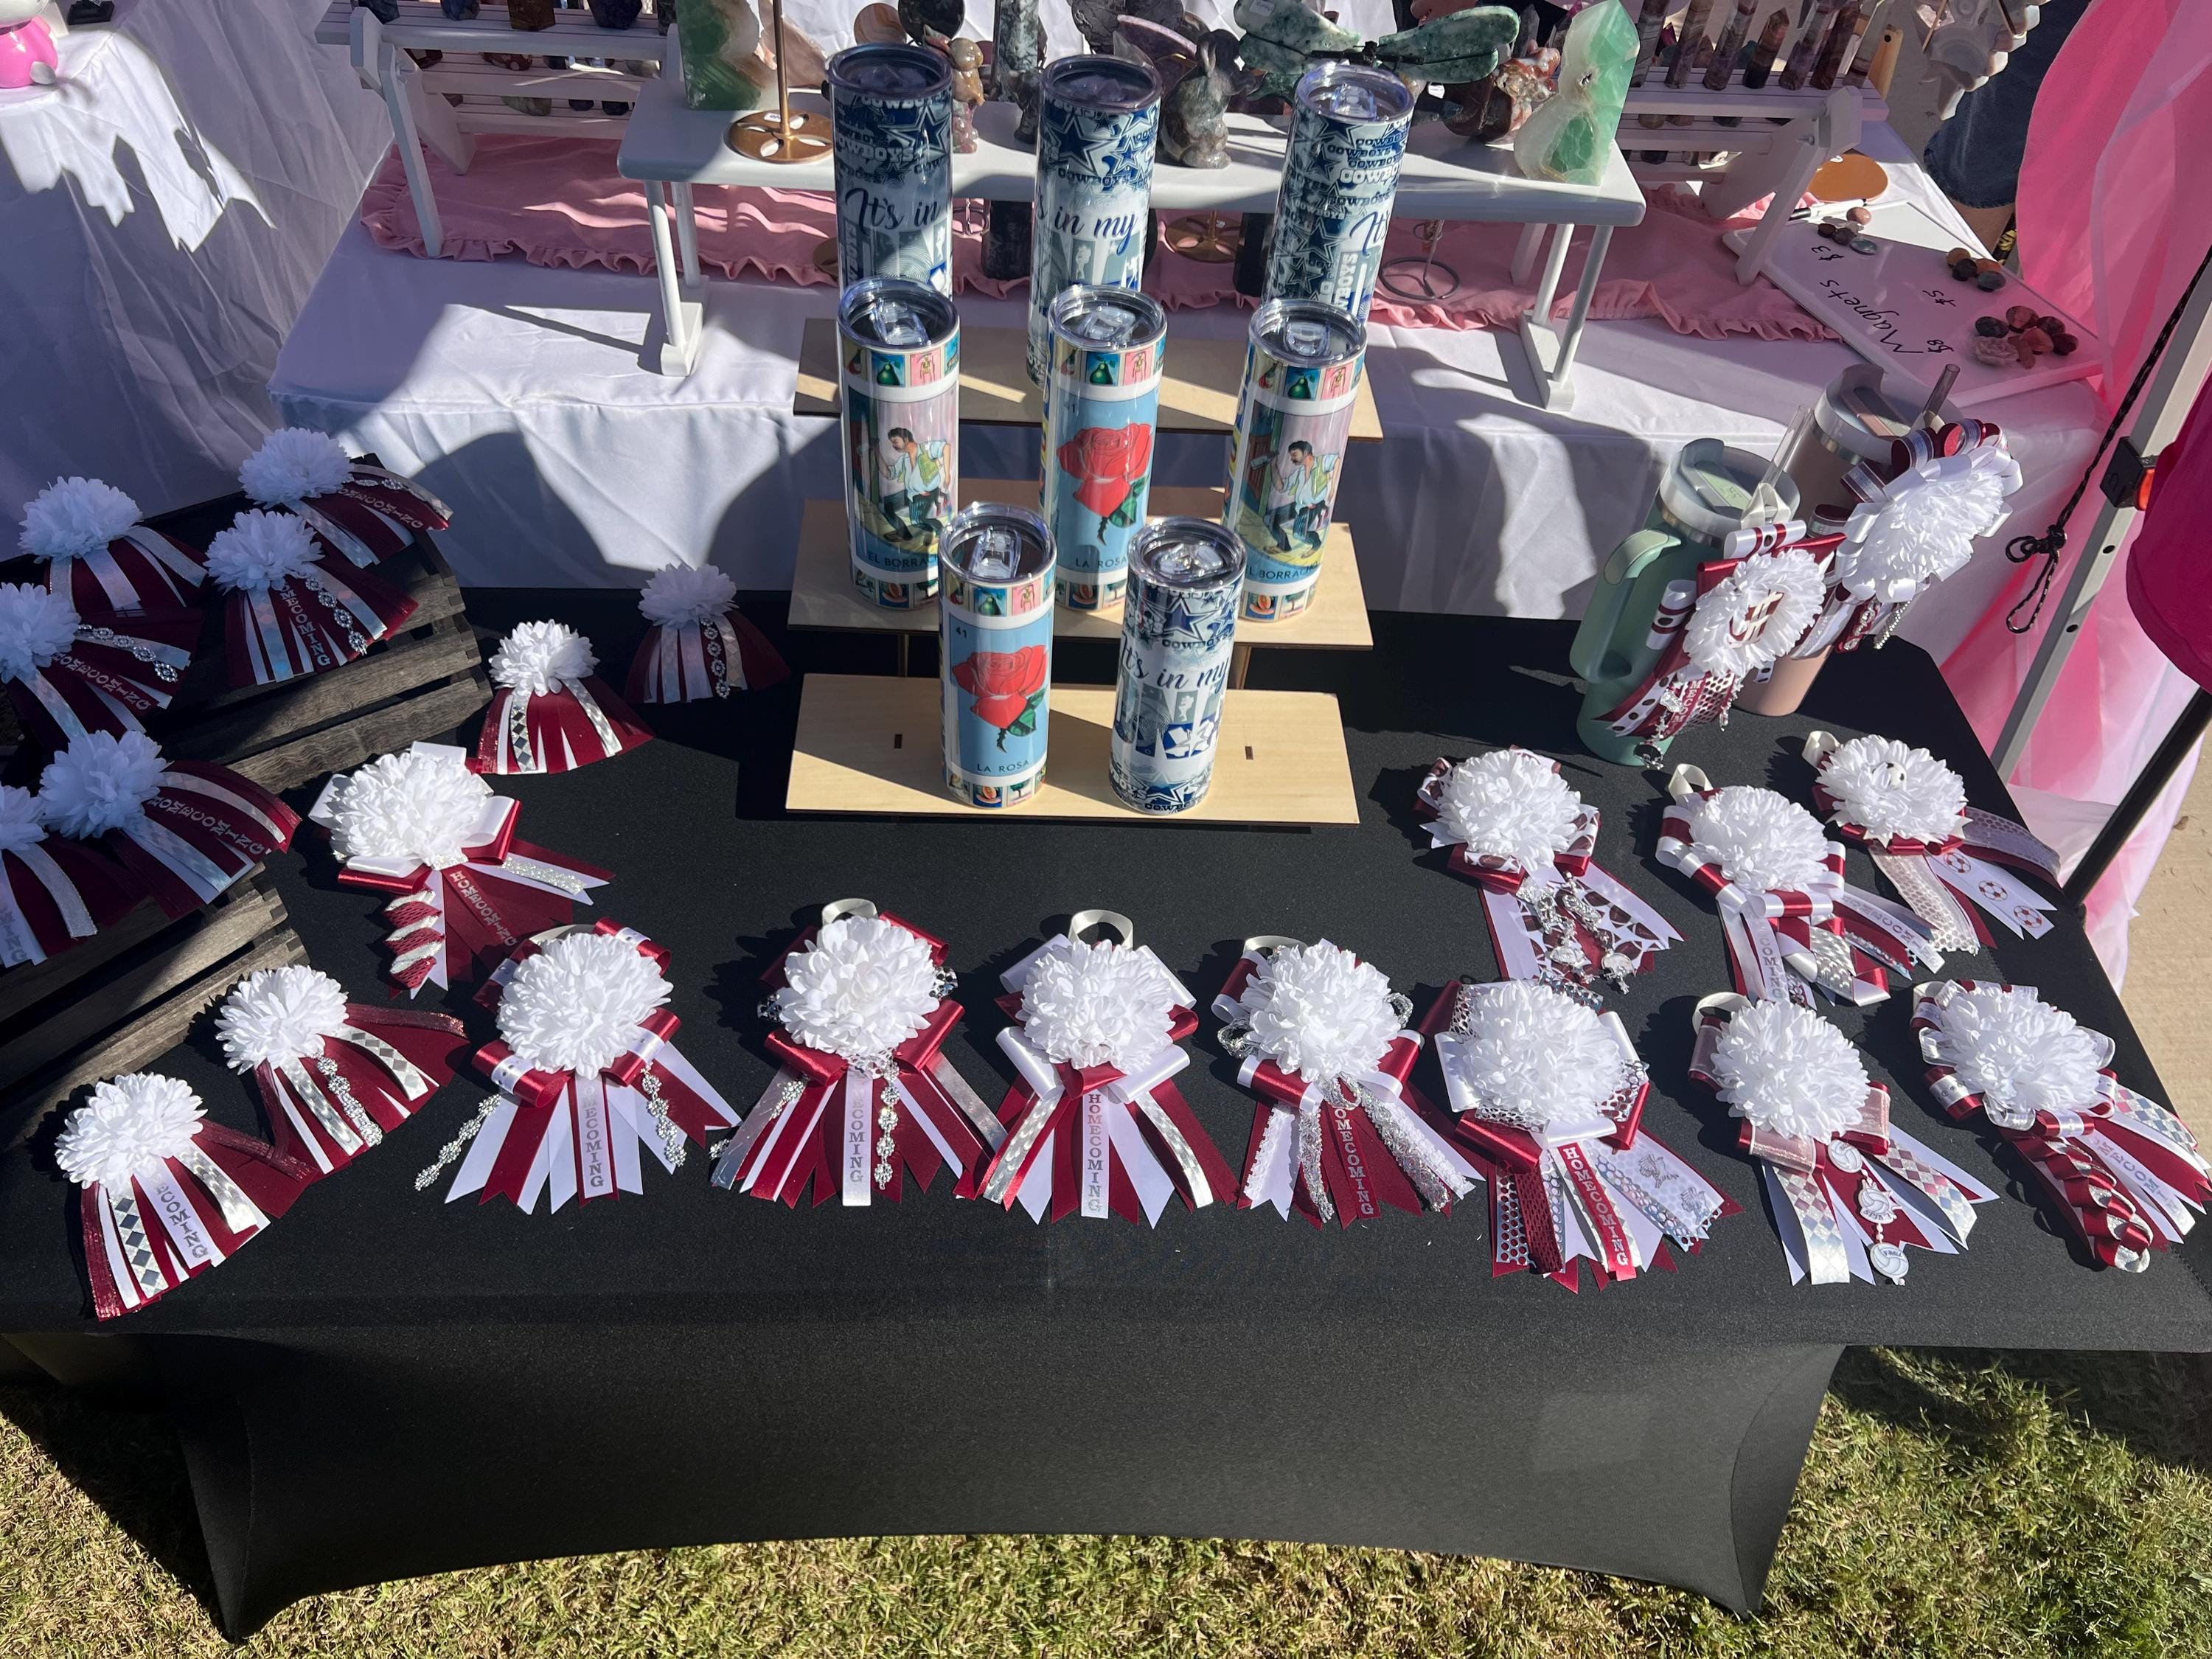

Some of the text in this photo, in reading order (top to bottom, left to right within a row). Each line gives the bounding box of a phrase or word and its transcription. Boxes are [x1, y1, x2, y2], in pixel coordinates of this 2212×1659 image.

[836, 133, 914, 162] OWBOYS
[1328, 145, 1393, 158] COWBOYS
[844, 188, 943, 237] It's in
[1054, 205, 1085, 235] in
[1093, 212, 1138, 256] my
[1811, 246, 1845, 261] $3
[1819, 279, 1924, 353] Magnets
[1922, 290, 1957, 307] $5
[1926, 339, 1955, 353] $8
[338, 488, 424, 529] OMECOMING
[869, 552, 880, 564] EL
[1075, 556, 1127, 568] LA ROSA
[1259, 561, 1318, 580] BORRACHO
[279, 585, 331, 667] MECOMING
[956, 627, 967, 639] 41
[1156, 668, 1189, 689] in
[1197, 658, 1229, 694] my
[977, 759, 1029, 773] LA ROSA
[148, 796, 265, 855] HOMECOMING
[450, 870, 518, 947] HOMECOMING
[1759, 936, 1783, 997] COMING
[583, 1084, 605, 1188] OMECOMING
[849, 1088, 866, 1183] MECOMING
[1087, 1093, 1105, 1213] HOMECOMING
[1334, 1107, 1374, 1216] OMECOMING
[155, 1182, 209, 1259] ECOMING
[1562, 1146, 1629, 1267] HOMECOMING
